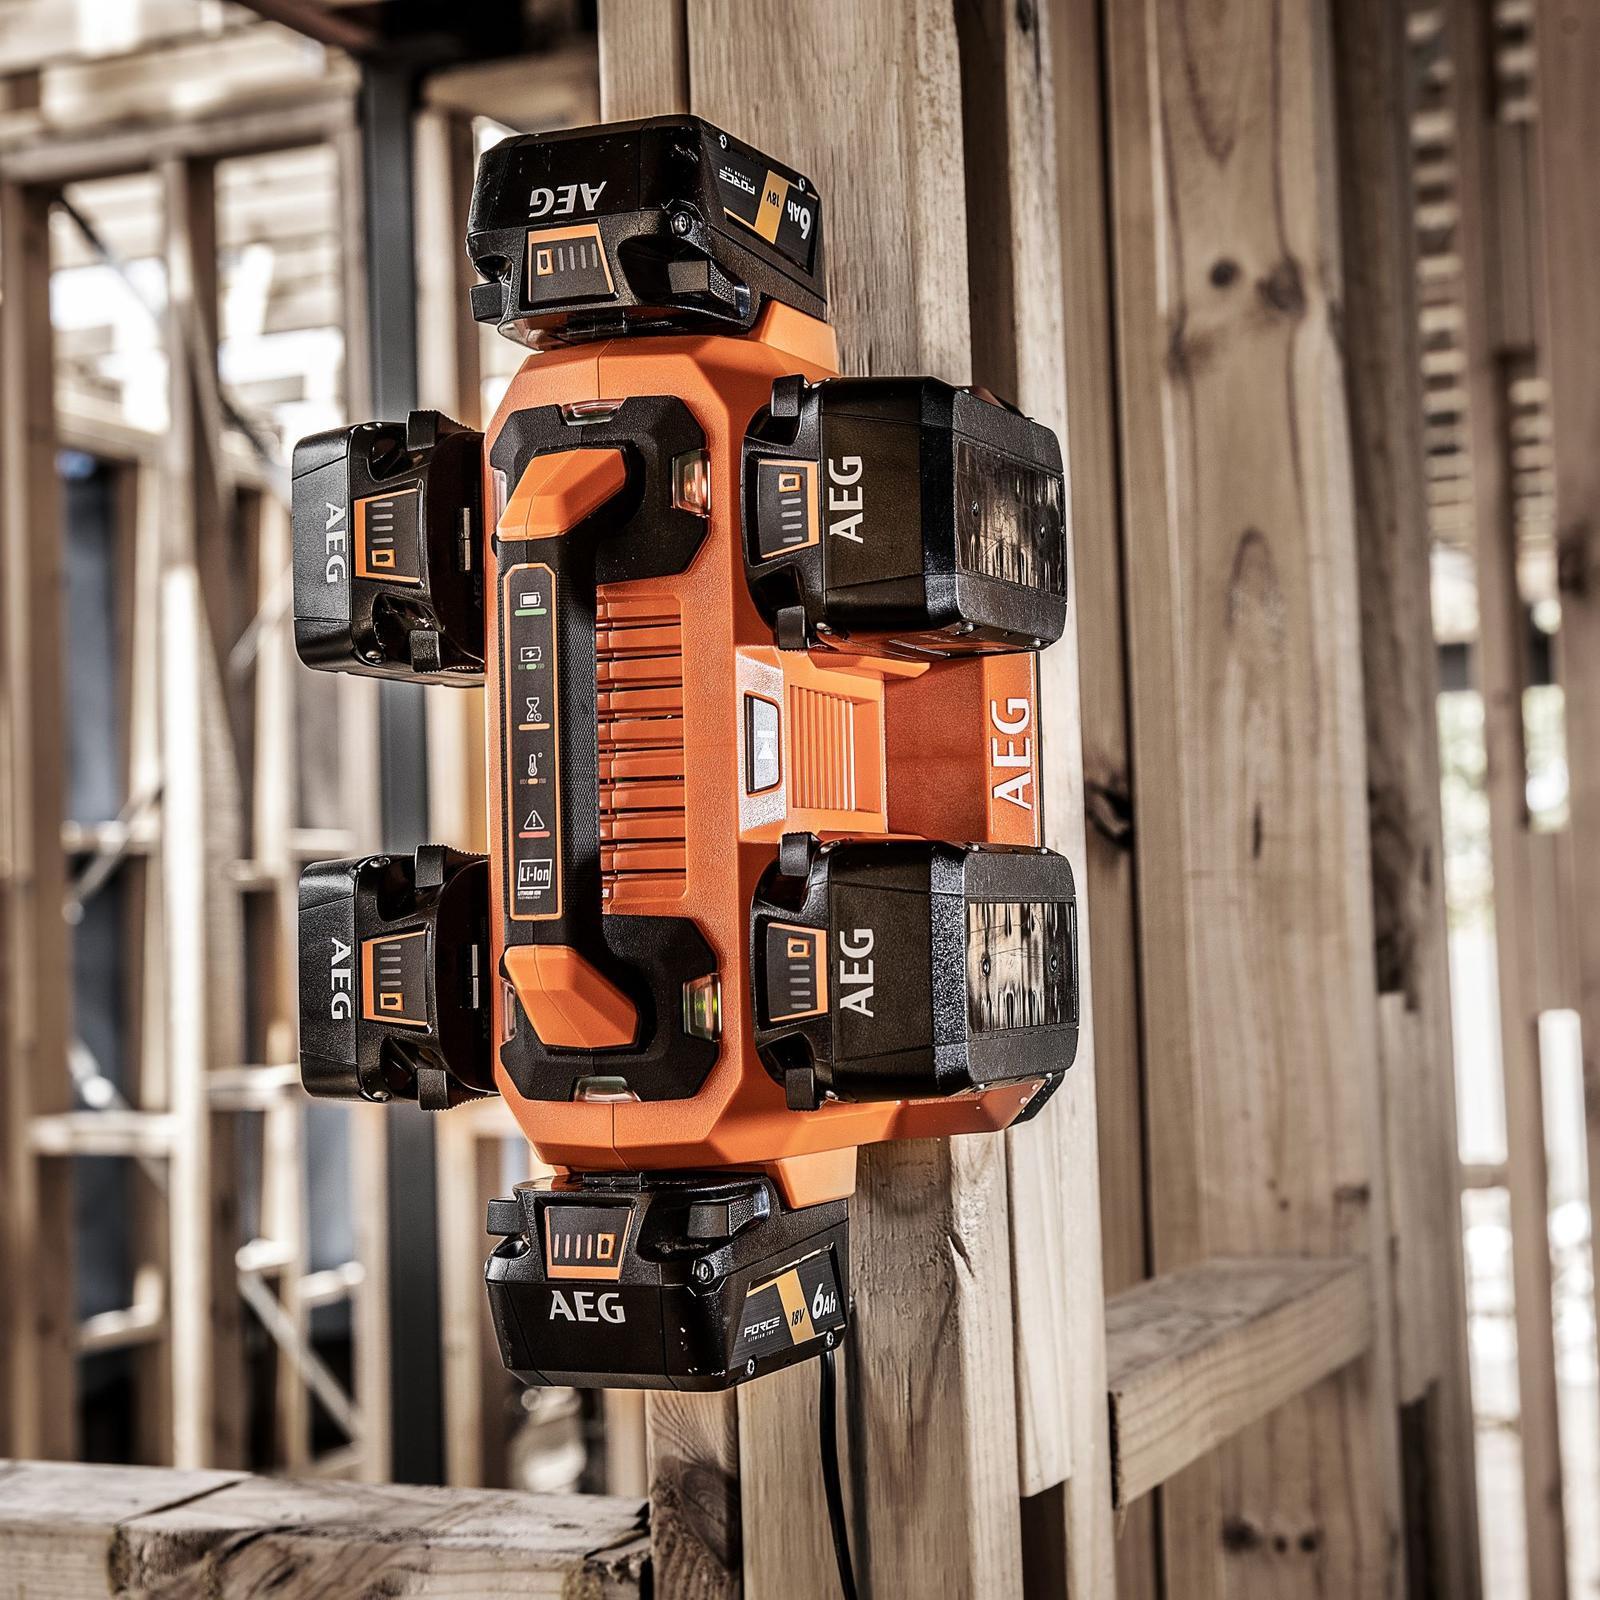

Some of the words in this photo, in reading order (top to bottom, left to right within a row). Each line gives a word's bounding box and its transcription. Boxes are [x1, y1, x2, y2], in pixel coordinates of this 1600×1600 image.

[528, 181, 607, 218] AEG
[719, 169, 756, 195] FORCE
[766, 190, 780, 208] 18V
[787, 199, 811, 240] 6Ah
[828, 456, 864, 544] AEG
[325, 502, 347, 584] AEG
[991, 697, 1033, 811] AEG
[520, 865, 549, 882] Li-Ion
[331, 937, 352, 1020] AEG
[839, 928, 875, 1018] AEG
[549, 1290, 626, 1324] AEG
[791, 1308, 806, 1327] 18V
[812, 1282, 836, 1320] 6Ah
[743, 1316, 780, 1338] FORCE
